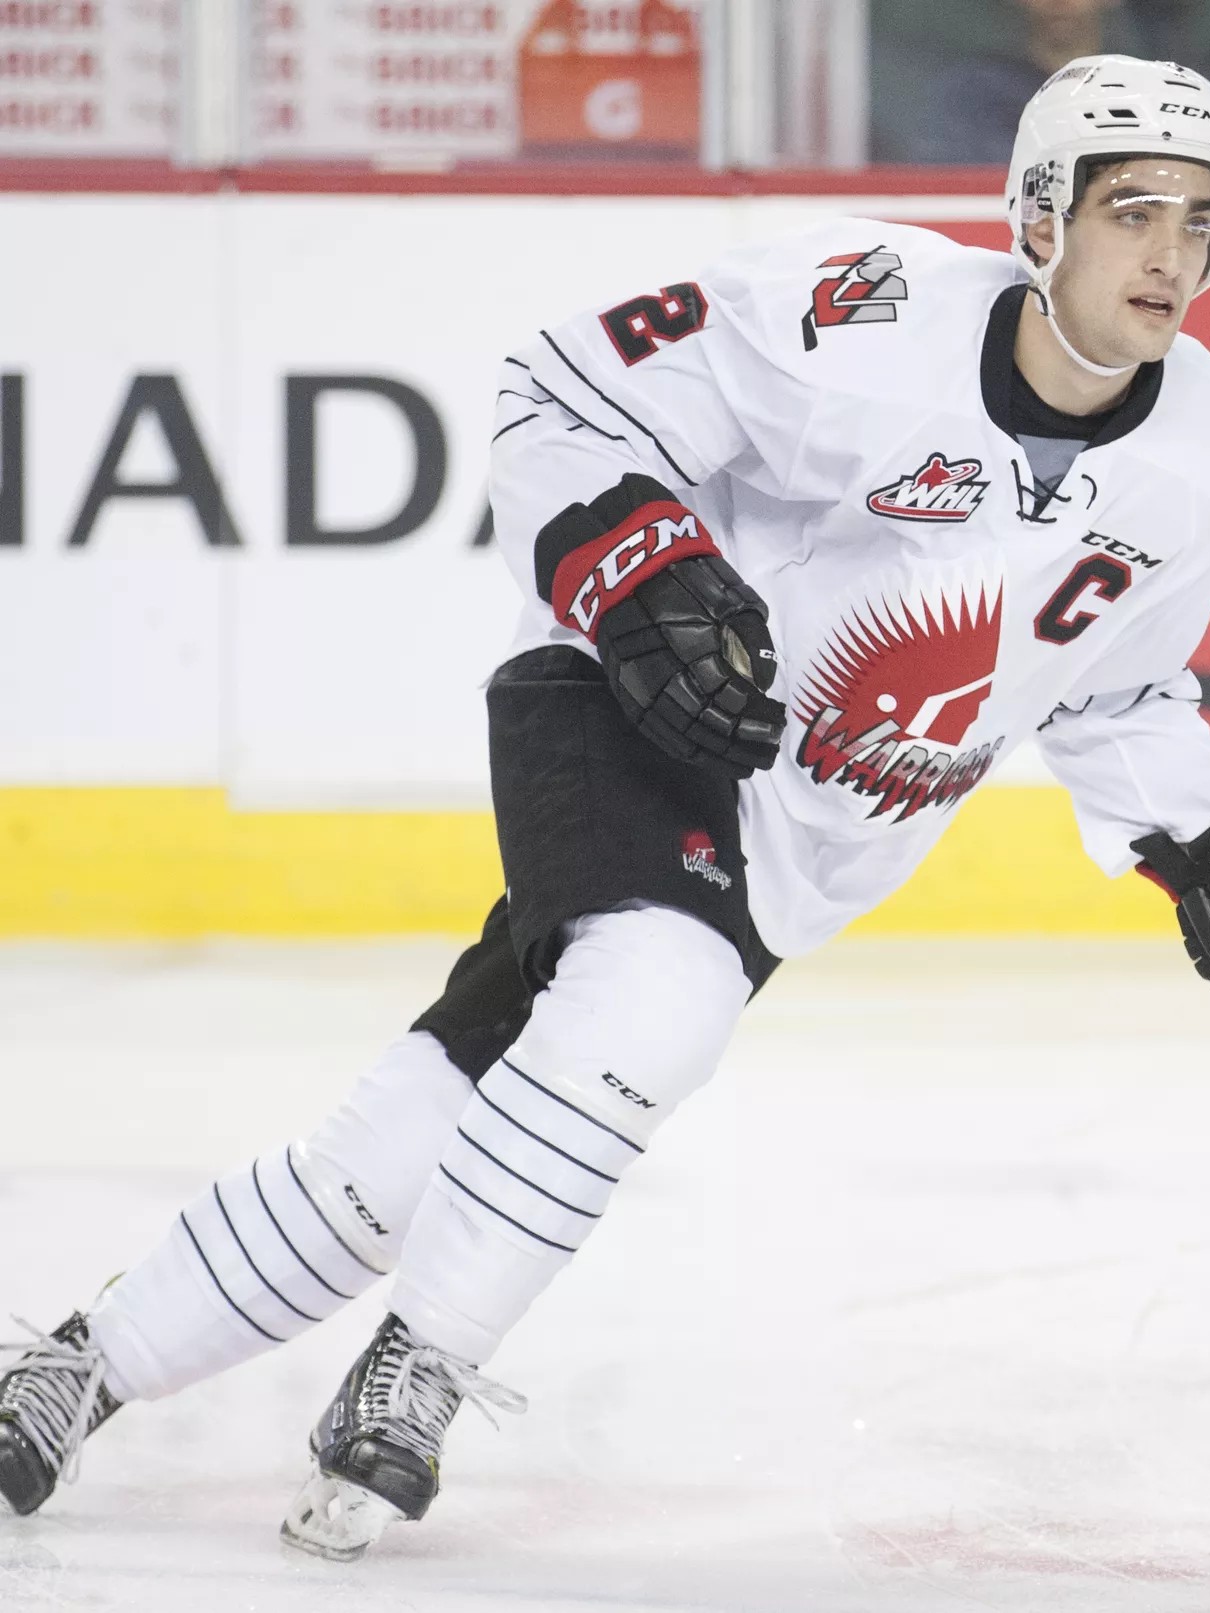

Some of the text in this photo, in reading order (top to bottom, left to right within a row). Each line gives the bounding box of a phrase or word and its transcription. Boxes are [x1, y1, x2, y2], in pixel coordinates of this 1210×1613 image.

[598, 281, 709, 368] 2
[0, 373, 496, 546] AD
[893, 480, 991, 511] WHL
[564, 514, 700, 633] CCM
[1081, 530, 1162, 569] CCM
[1033, 552, 1132, 646] C
[601, 1071, 656, 1108] CCM
[344, 1184, 389, 1235] CCM
